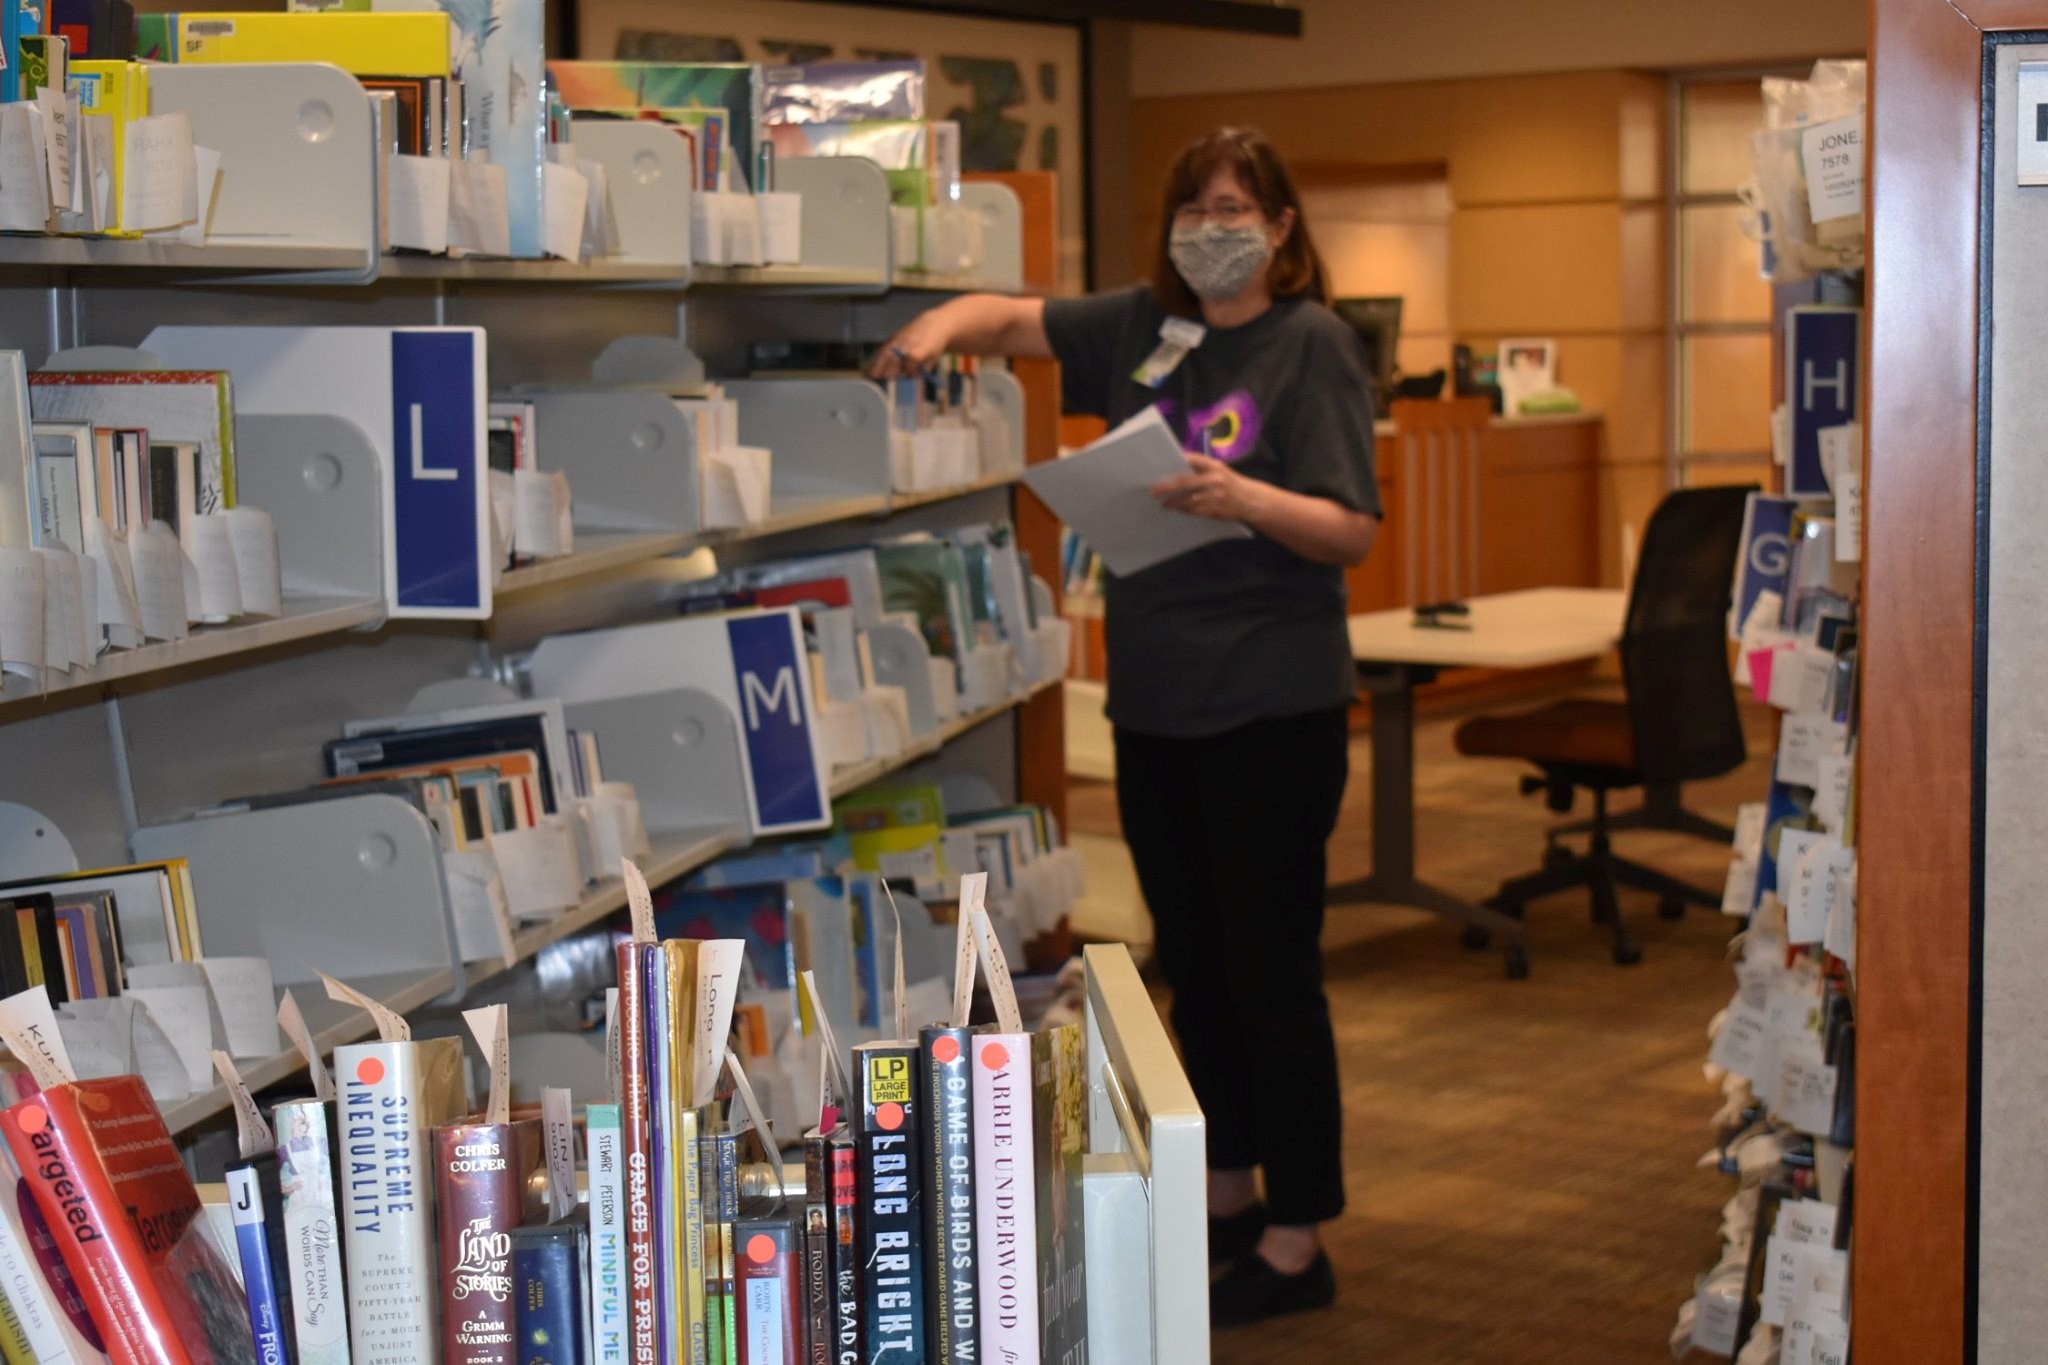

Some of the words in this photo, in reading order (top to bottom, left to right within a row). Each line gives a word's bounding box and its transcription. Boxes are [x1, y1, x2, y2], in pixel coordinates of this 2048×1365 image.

[186, 40, 203, 53] SF
[1819, 131, 1862, 151] JONE
[1803, 359, 1846, 411] H
[411, 404, 459, 480] L
[1749, 532, 1791, 576] G
[742, 666, 802, 731] M
[874, 1060, 904, 1080] LP
[873, 1082, 906, 1092] LARGE
[876, 1091, 905, 1101] PRINT
[932, 1072, 942, 1121] INGENIOUS
[947, 1077, 968, 1145] GAME
[991, 1060, 1013, 1148] ARRIE
[381, 1096, 414, 1214] SUPREME
[455, 1143, 500, 1157] CHRIS
[599, 1135, 611, 1174] STEWART
[687, 1137, 698, 1158] The
[934, 1123, 943, 1154] YOUNG
[347, 1082, 381, 1234] INEQUALITY
[450, 1159, 506, 1172] COLFER
[935, 1156, 944, 1190] WOMEN
[949, 1156, 969, 1184] OF
[686, 1161, 699, 1194] Paper
[872, 1135, 908, 1215] LONG
[238, 1182, 252, 1211] J
[601, 1184, 614, 1226] PETERSON
[629, 1152, 647, 1234] GRACE
[688, 1198, 700, 1219] Bag
[724, 1191, 733, 1217] HOUSE
[935, 1193, 945, 1222] WHOSE
[300, 1225, 313, 1268] WORDS
[691, 1223, 701, 1269] Princess
[936, 1227, 946, 1259] SECRET
[950, 1197, 971, 1269] BIRDS
[994, 1157, 1018, 1330] UNDERWOOD
[452, 1229, 511, 1271] LAND
[491, 1259, 508, 1273] OF
[633, 1242, 650, 1290] FOR
[317, 1265, 330, 1300] THAN
[452, 1274, 512, 1301] STORIES
[601, 1234, 618, 1324] MINDFUL
[813, 1250, 823, 1303] RODDA
[875, 1231, 913, 1352] BRIGHT
[937, 1261, 947, 1292] BOARD
[13, 1272, 44, 1331] Chakras
[535, 1281, 543, 1308] CHRIS
[755, 1285, 764, 1310] CARR
[763, 1281, 771, 1313] ROBYN
[938, 1293, 948, 1319] GAME
[952, 1280, 973, 1328] AND
[302, 1296, 326, 1329] Say
[370, 1311, 411, 1322] BATTLE
[462, 1321, 505, 1332] GRIMM
[479, 1311, 487, 1319] A
[841, 1301, 857, 1345] BAD
[371, 1341, 412, 1351] UNJUST
[456, 1332, 512, 1344] WARNING
[603, 1330, 620, 1361] ME
[939, 1321, 948, 1354] HELPED
